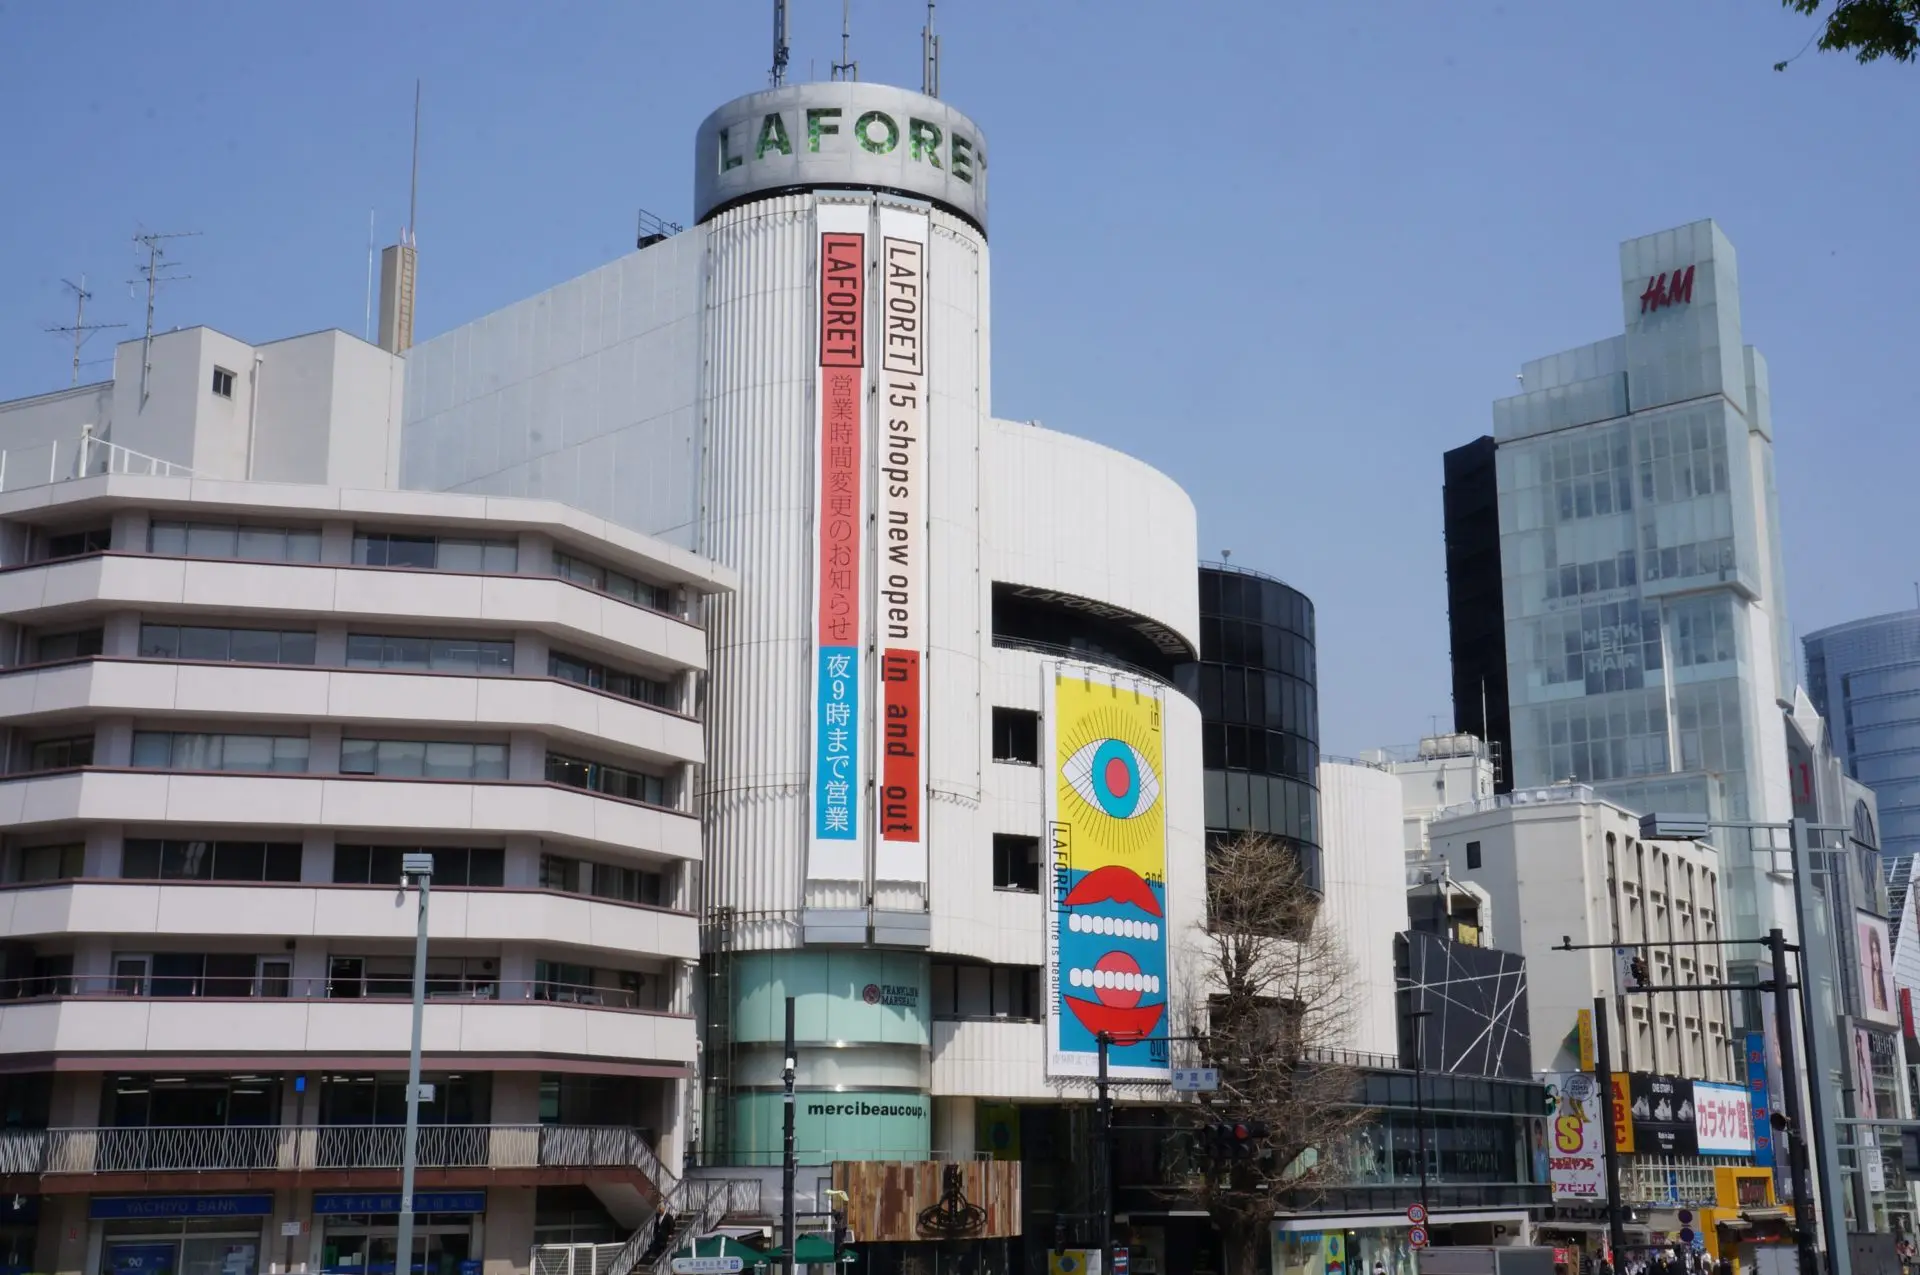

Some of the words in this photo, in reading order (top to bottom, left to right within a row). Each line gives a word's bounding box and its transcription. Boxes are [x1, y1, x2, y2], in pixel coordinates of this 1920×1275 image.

[827, 242, 857, 359] LAFORET
[889, 247, 916, 366] LAFORET
[1640, 264, 1695, 314] H&M
[889, 381, 917, 409] 15
[881, 419, 917, 499] shops
[827, 374, 853, 641] 営業時間変更のお知らせ
[888, 511, 909, 567] new
[881, 575, 909, 639] open
[887, 656, 916, 682] in
[1588, 653, 1639, 673] HAIR
[887, 705, 915, 757] and
[1150, 704, 1160, 727] in
[824, 654, 851, 831] 夜9時まで営業
[886, 786, 912, 832] out
[1145, 868, 1162, 888] and
[1051, 961, 1062, 1016] beautiful
[1150, 1039, 1167, 1058] out
[808, 1101, 927, 1119] mercibeaucoup,
[1698, 1099, 1749, 1139] カラオケ館
[196, 1200, 239, 1212] BANK
